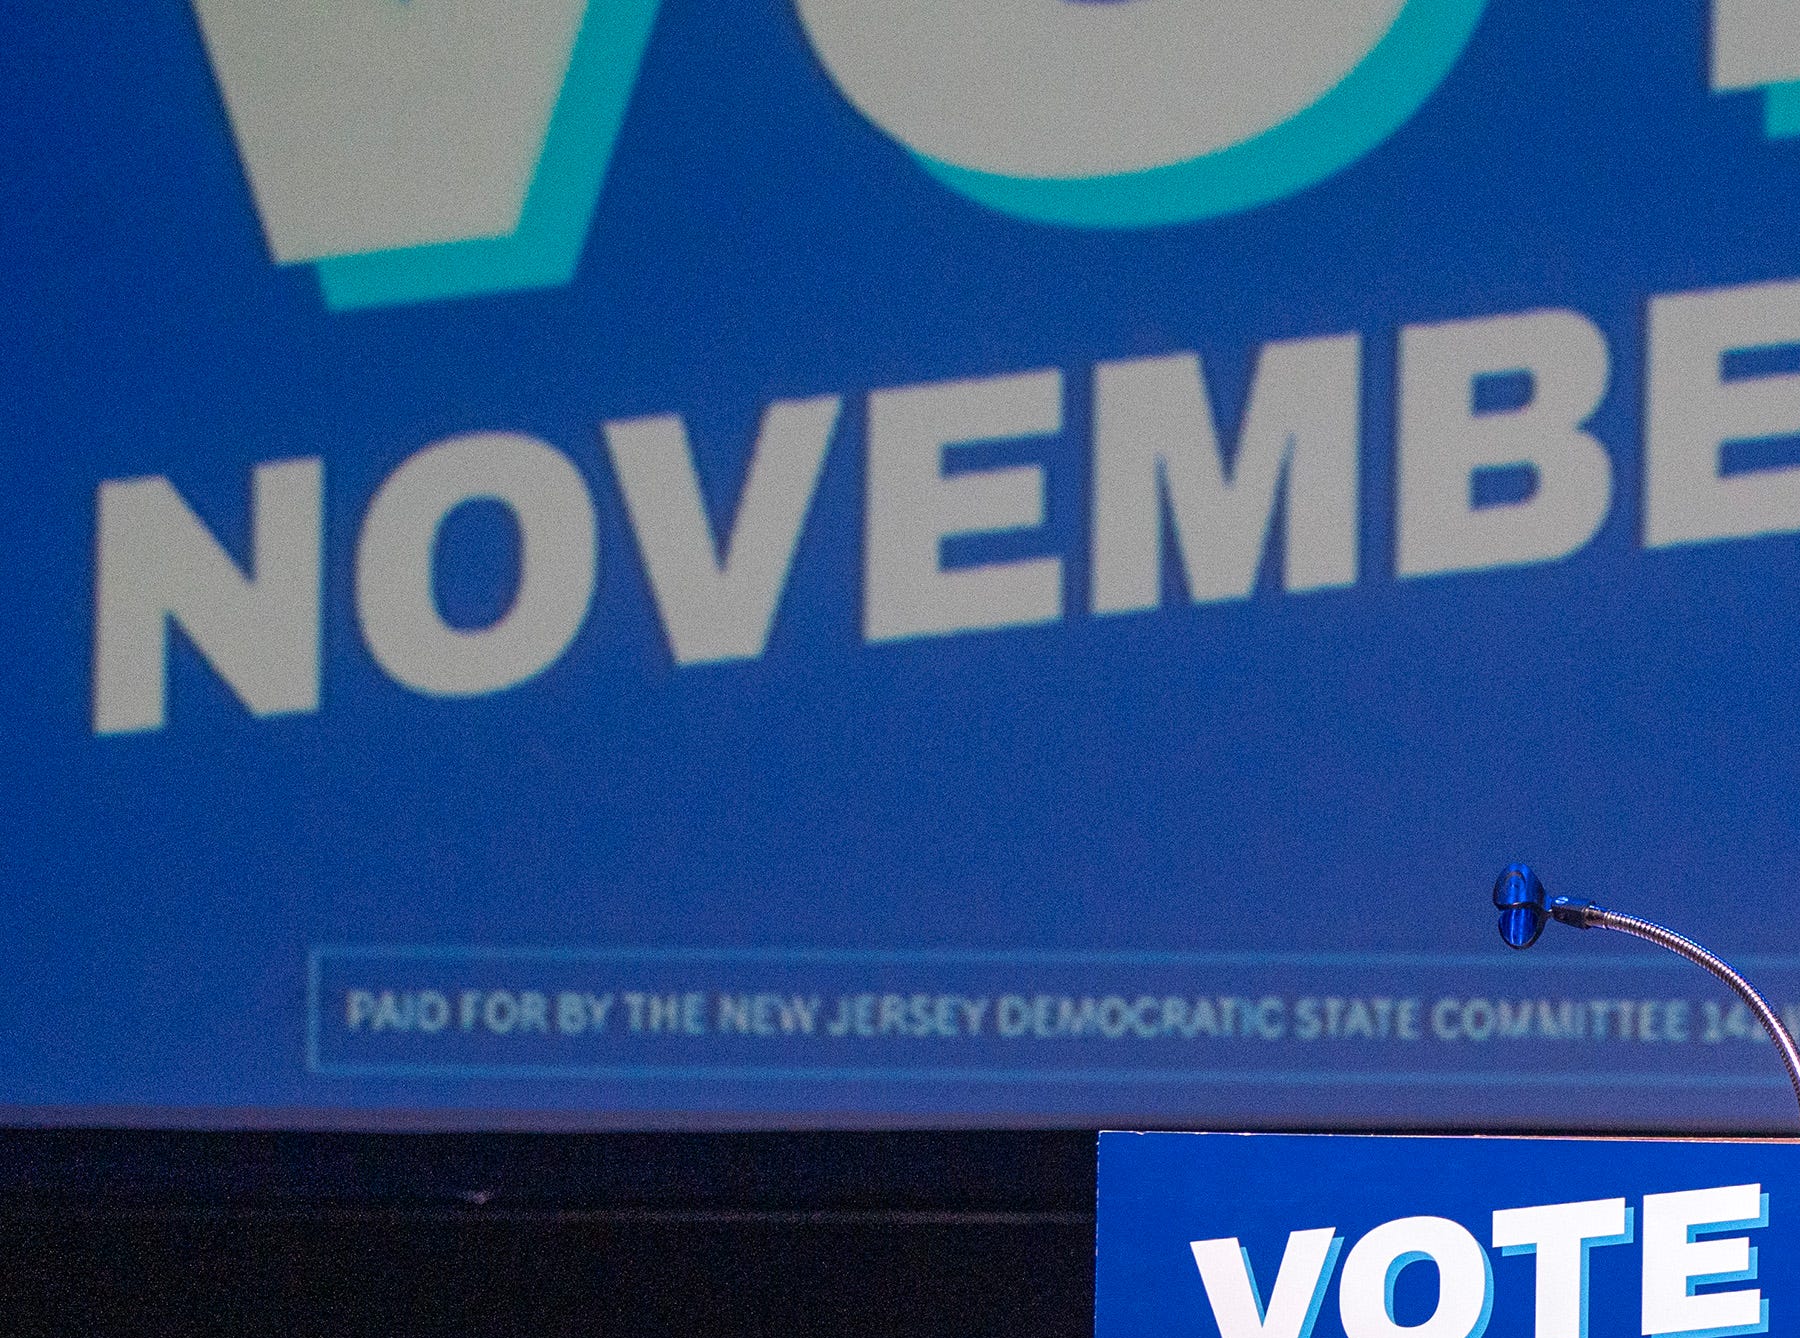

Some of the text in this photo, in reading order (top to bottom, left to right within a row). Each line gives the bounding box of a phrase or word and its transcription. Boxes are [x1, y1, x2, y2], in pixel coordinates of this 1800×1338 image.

[346, 990, 450, 1032] PAID
[460, 991, 549, 1033] FOR
[556, 991, 612, 1033] BY
[623, 992, 703, 1034] THE
[718, 992, 820, 1034] NEW
[827, 993, 985, 1035] JERSEY
[998, 994, 1282, 1037] DEMOCRATIC
[1293, 996, 1417, 1038] STATE
[1431, 997, 1689, 1040] COMMITTEE
